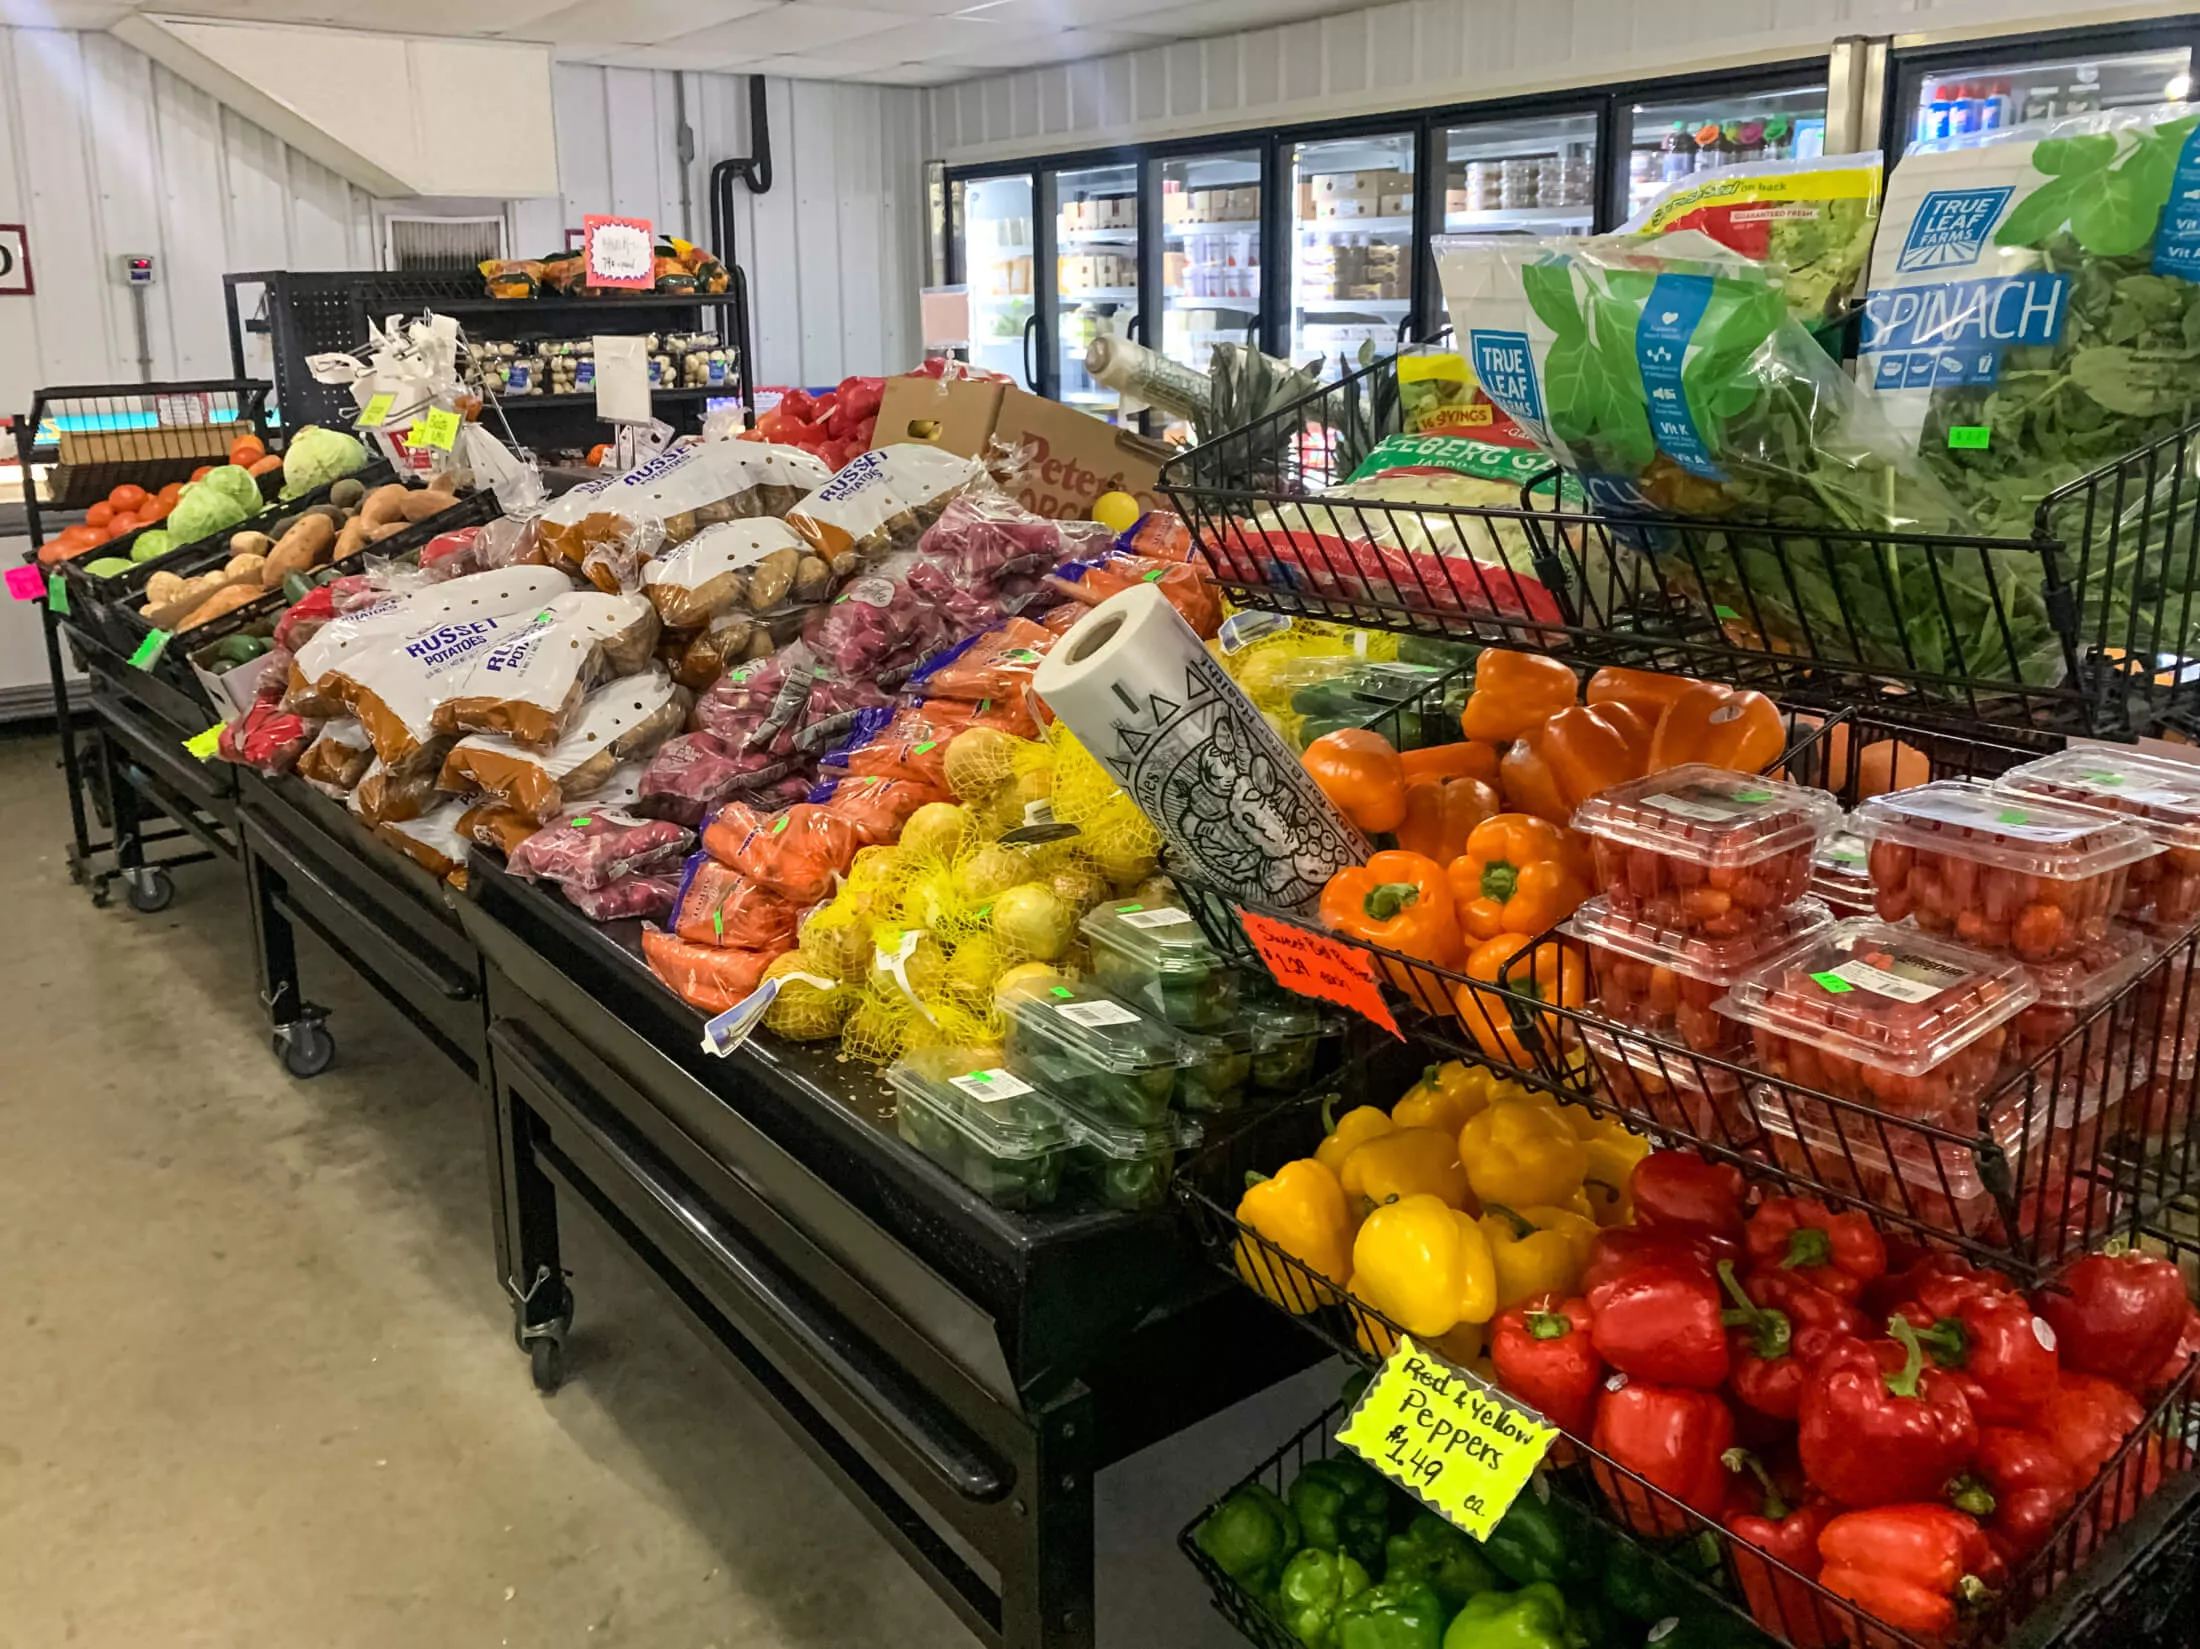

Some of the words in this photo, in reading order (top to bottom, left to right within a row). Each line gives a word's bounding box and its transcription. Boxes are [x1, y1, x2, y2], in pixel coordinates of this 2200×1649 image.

[1933, 198, 1996, 215] TRUE
[1919, 228, 1974, 246] FARMS
[1924, 214, 1985, 233] LEAF
[1860, 279, 2063, 348] SPINACH
[1482, 346, 1526, 374] TRUE
[1488, 373, 1528, 400] LEAF
[819, 450, 888, 502] RUSSET
[836, 468, 884, 501] POTATOES
[405, 618, 499, 659] RUSSET
[424, 635, 488, 666] POTATOES
[1402, 1357, 1451, 1396] Red
[1453, 1390, 1469, 1410] &
[1471, 1398, 1535, 1446] Yellow
[1398, 1388, 1504, 1471] Peppers
